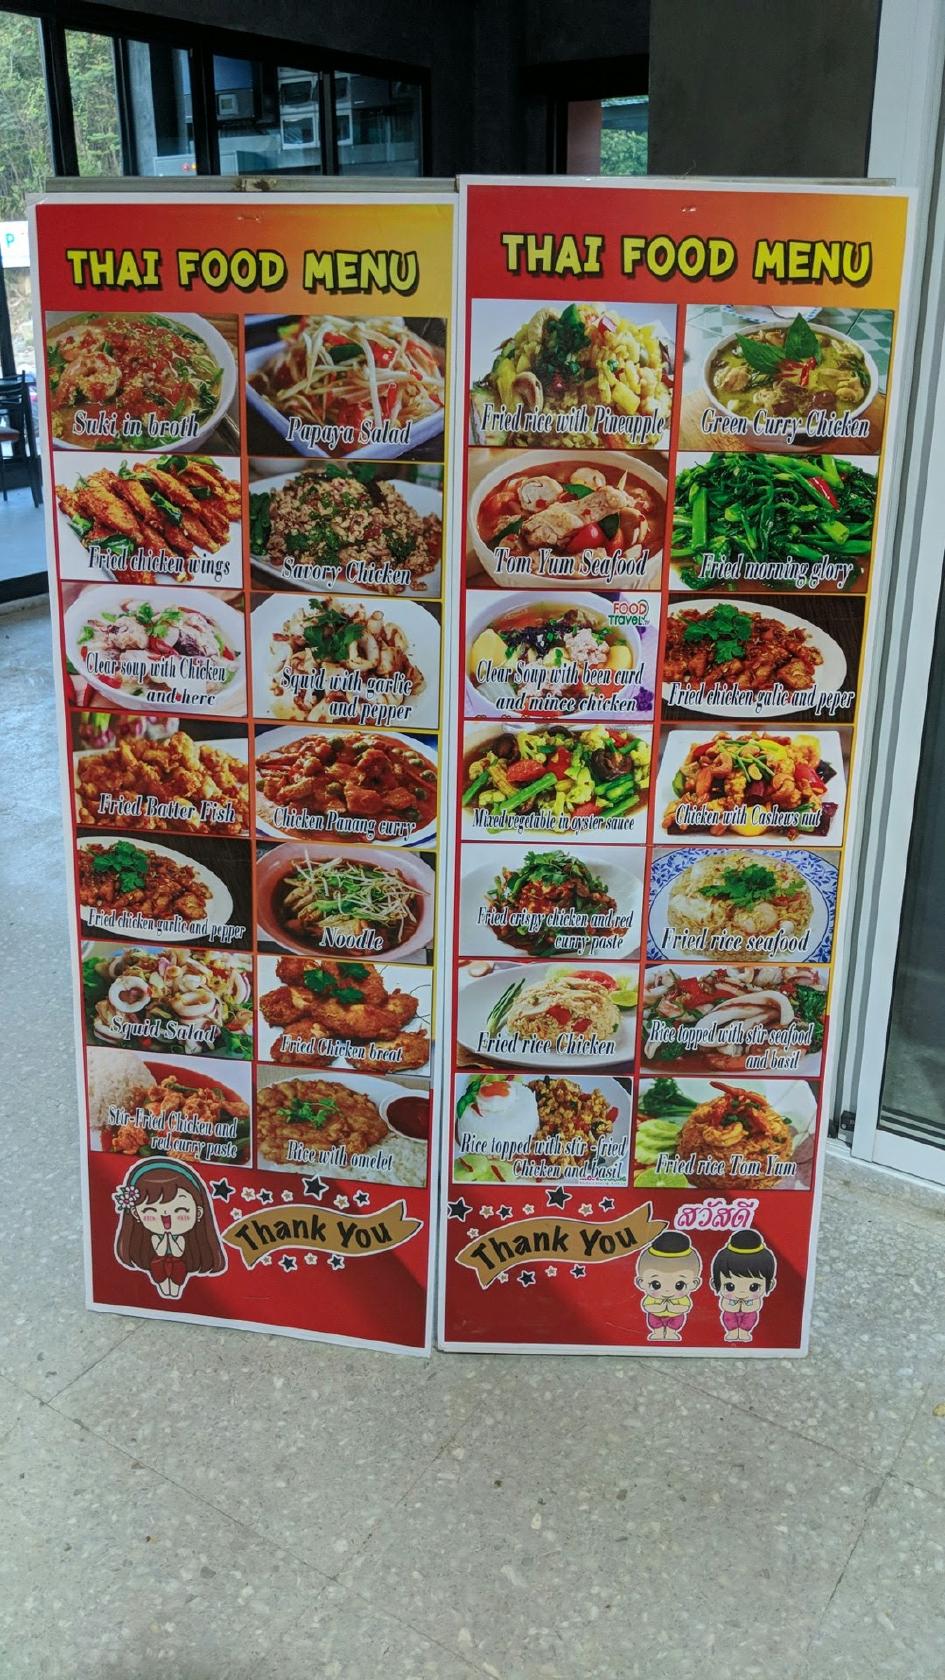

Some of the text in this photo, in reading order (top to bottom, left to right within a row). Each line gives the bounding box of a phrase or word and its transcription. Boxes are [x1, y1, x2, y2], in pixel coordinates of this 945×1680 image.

[66, 248, 420, 296] THAI FOOD MENU
[502, 233, 873, 286] THAI FOOD MENU
[74, 410, 199, 437] Suki in broth
[287, 416, 411, 449] Papaya Salad
[481, 403, 665, 443] Fried rice with Pineapple
[702, 408, 869, 443] Green Curry Chicken
[89, 546, 230, 582] Fried chicken wings
[282, 558, 411, 587] Savory Chicken
[494, 548, 649, 583] Tom Yum Seafood
[700, 553, 852, 587] Fried morning glory
[613, 603, 647, 614] FOOD
[86, 652, 225, 682] Clear soup with Chicken
[477, 660, 512, 683] Clear
[514, 662, 546, 690] Soup
[550, 663, 578, 684] with
[615, 662, 644, 684] curd
[147, 688, 177, 704] and
[281, 667, 412, 698] Squid with garlic
[330, 698, 412, 726] and pepper
[496, 694, 636, 711] and mince chicken
[668, 682, 706, 706] Fried
[707, 683, 753, 706] chicken
[792, 685, 817, 707] and
[816, 691, 855, 715] peper
[98, 793, 235, 822] Fried Batter Fish
[473, 808, 635, 834] Mixed vegetable in oyster sauce
[676, 804, 822, 827] Chicken with Cashews nut
[273, 808, 416, 841] Chicken Panang curry
[88, 909, 246, 943] Fried chicken garlic and pepper
[478, 907, 633, 931] Fried crispy chicken and red
[319, 926, 384, 949] Noodle
[555, 935, 623, 954] curry paste
[661, 928, 810, 956] Fried rice seafood
[111, 1016, 216, 1042] Squid Salad
[650, 1020, 814, 1051] Rice topped with stir seafood
[281, 1035, 314, 1052] Fried
[317, 1038, 366, 1059] Chicken
[476, 1032, 615, 1055] Fried rice Chicken
[746, 1049, 800, 1069] and basil
[167, 1112, 213, 1134] Chicken
[215, 1117, 237, 1138] and
[151, 1134, 237, 1159] red curry paste
[287, 1140, 392, 1170] Rice with omelet
[461, 1133, 487, 1153] Rice
[491, 1135, 531, 1161] topped
[535, 1136, 560, 1155] with
[513, 1159, 622, 1178] Chicken and basil
[656, 1153, 797, 1176] Fried rice Tom Yum
[677, 1200, 755, 1228] สวัสดี
[235, 1214, 392, 1250] Thank You
[470, 1225, 638, 1270] Thank You
